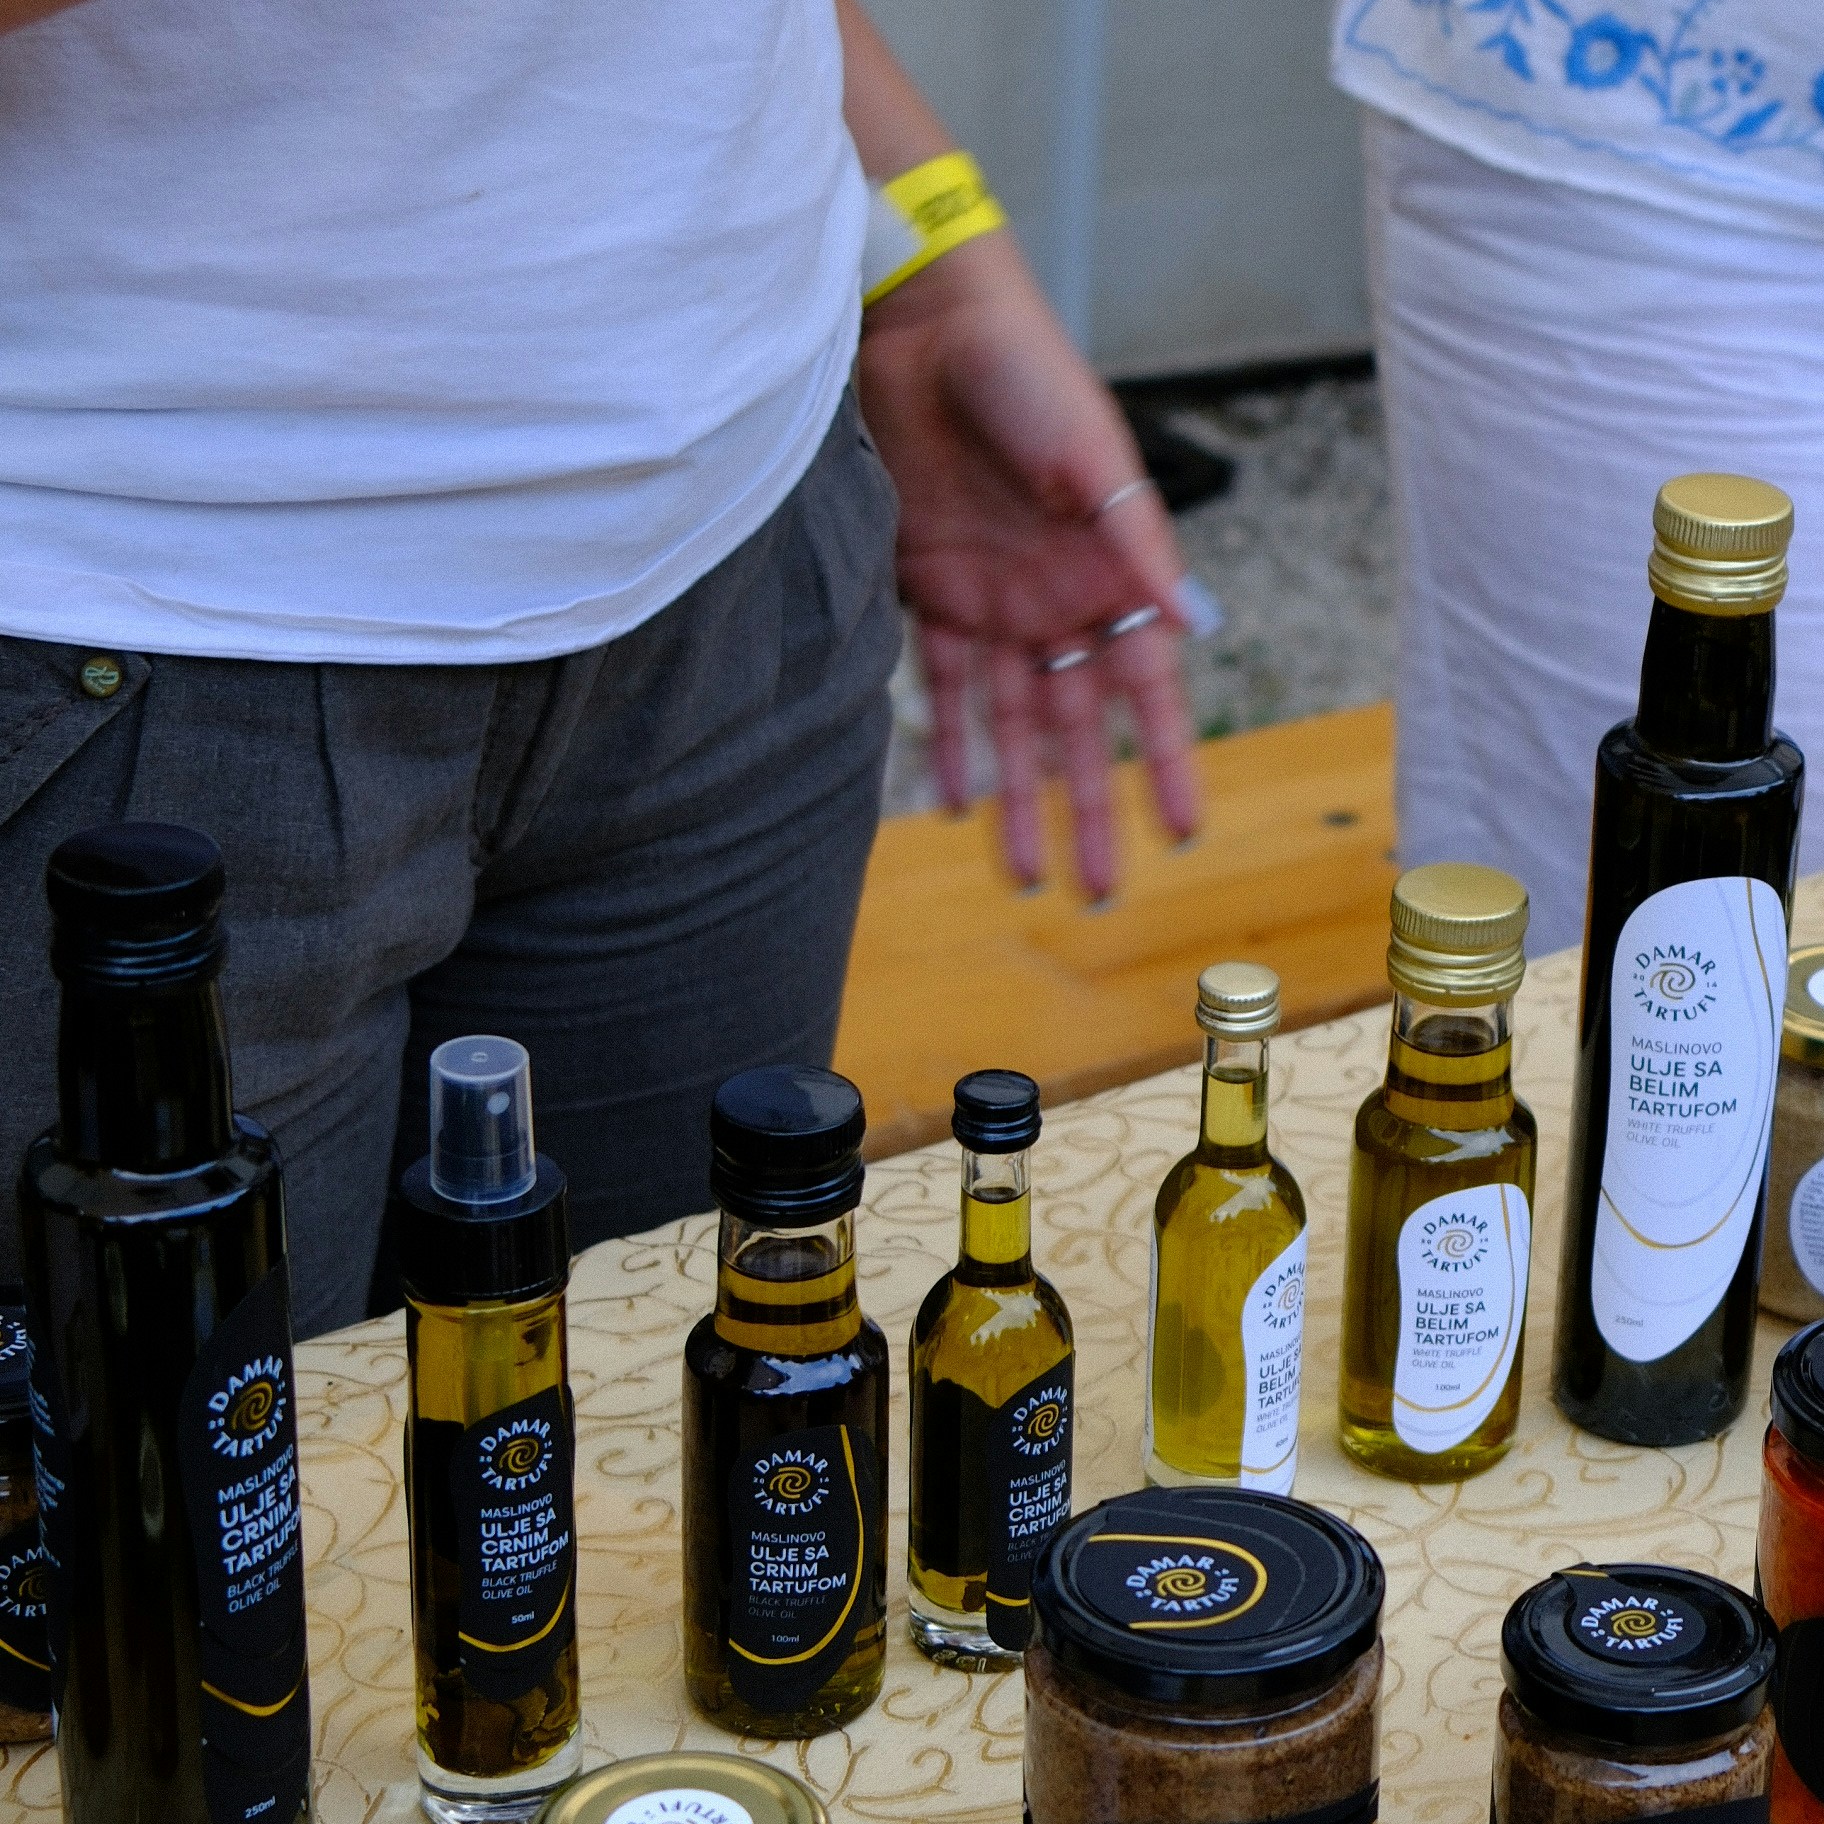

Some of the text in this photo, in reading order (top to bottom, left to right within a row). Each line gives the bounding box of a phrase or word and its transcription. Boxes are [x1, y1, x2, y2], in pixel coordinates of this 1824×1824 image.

[1635, 944, 1717, 976] DAMAR
[1633, 989, 1717, 1023] TARTUFI
[1631, 1036, 1723, 1055] MASLINOVO
[1630, 1054, 1723, 1078] ULJE SA
[1629, 1075, 1700, 1098] BELIM
[1628, 1096, 1737, 1119] TARTUFOM
[1626, 1132, 1681, 1149] OLIVE OIL
[1627, 1117, 1716, 1135] WHITE TRUFFLE
[1423, 1212, 1489, 1235] DAMAR
[1421, 1248, 1489, 1272] TARTUFI
[1417, 1287, 1484, 1299] MASLINOVO
[1416, 1301, 1486, 1316] ULJE SA
[1414, 1325, 1500, 1346] TARTUFOM
[1415, 1316, 1469, 1331] BELIM
[1258, 1365, 1297, 1395] BELIM
[1259, 1356, 1292, 1379] ULJE
[208, 1354, 284, 1412] DAMAR
[1013, 1385, 1068, 1423] DAMAR
[212, 1396, 287, 1458] TARTUFI
[479, 1418, 551, 1453] DAMAR
[1012, 1416, 1069, 1456] TARTUFI
[217, 1443, 294, 1505] MASLINOVO
[480, 1452, 553, 1491] TARTUFI
[754, 1448, 829, 1475] DAMAR
[1010, 1457, 1066, 1490] MASLINOVO
[219, 1464, 297, 1529] ULJE SA
[753, 1487, 830, 1516] TARTUFI
[1009, 1471, 1068, 1507] ULJE SA
[480, 1492, 553, 1520] MASLINOVO
[1008, 1490, 1063, 1523] CRNIM
[220, 1492, 293, 1553] CRNIM
[480, 1506, 557, 1539] ULJE SA
[751, 1530, 827, 1544] MASLINOVO
[480, 1526, 549, 1556] CRNIM
[481, 1530, 570, 1574] TARTUFOM
[750, 1544, 830, 1562] ULJE SA
[226, 1568, 266, 1599] BLACK
[481, 1559, 559, 1588] BLACK TRUFFLE
[748, 1572, 848, 1595] TARTUFOM
[750, 1561, 819, 1579] CRNIM
[1125, 1554, 1215, 1589] DAMAR
[227, 1577, 282, 1614] OLIVE OIL
[481, 1583, 534, 1601] OLIVE OIL
[748, 1594, 781, 1608] BLACK
[1150, 1577, 1241, 1613] TARTUFI
[511, 1610, 535, 1625] 50ml
[780, 1608, 798, 1620] OIL
[1581, 1595, 1659, 1629] DAMAR
[771, 1633, 800, 1644] 100ml
[1605, 1617, 1684, 1650] TARTUFI
[245, 1795, 276, 1819] 250ml
